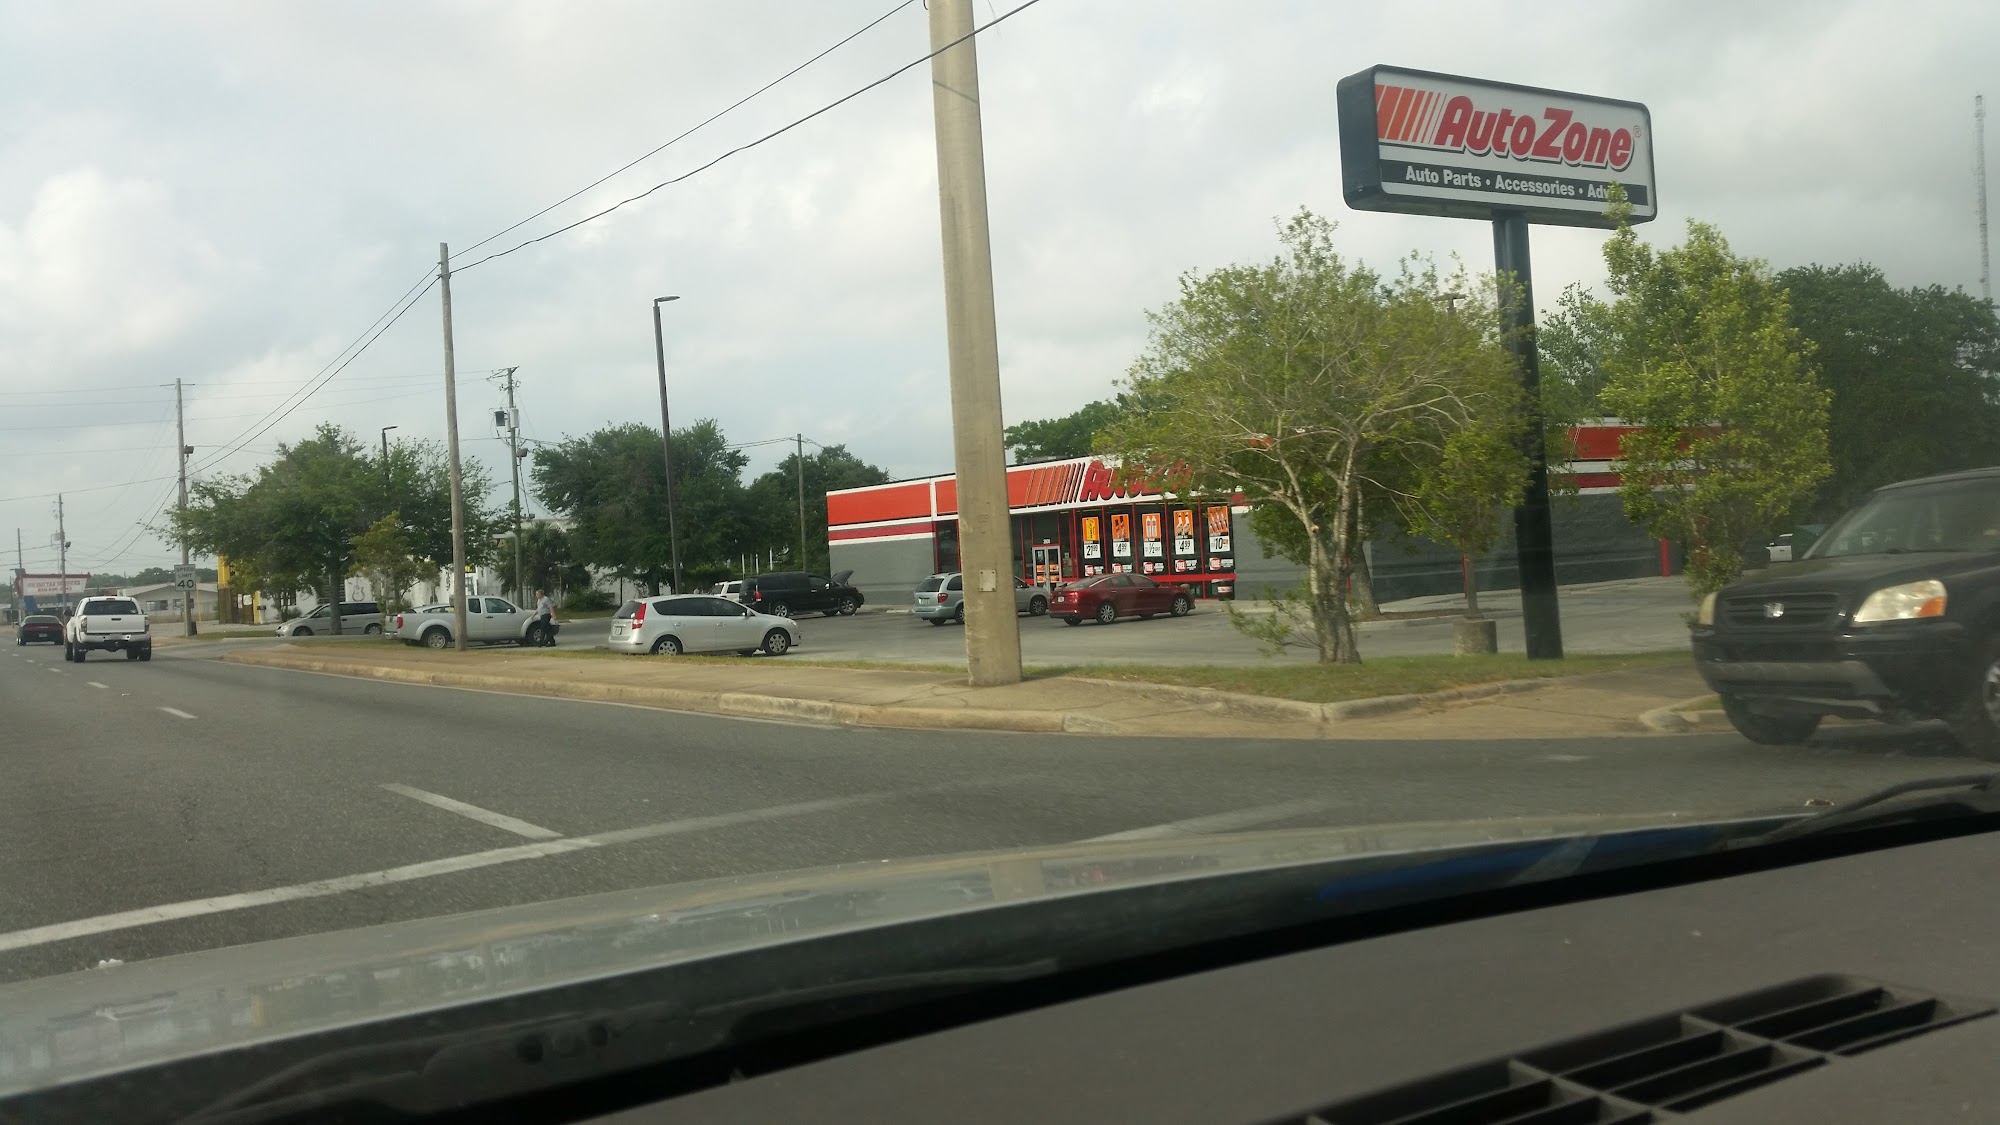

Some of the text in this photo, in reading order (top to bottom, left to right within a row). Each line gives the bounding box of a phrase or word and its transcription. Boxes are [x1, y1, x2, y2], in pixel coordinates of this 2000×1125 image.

[1434, 95, 1633, 171] AutoZone
[1406, 165, 1439, 184] Auto
[1443, 169, 1482, 188] Parts
[1495, 175, 1575, 197] Accessories
[177, 579, 194, 589] 40
